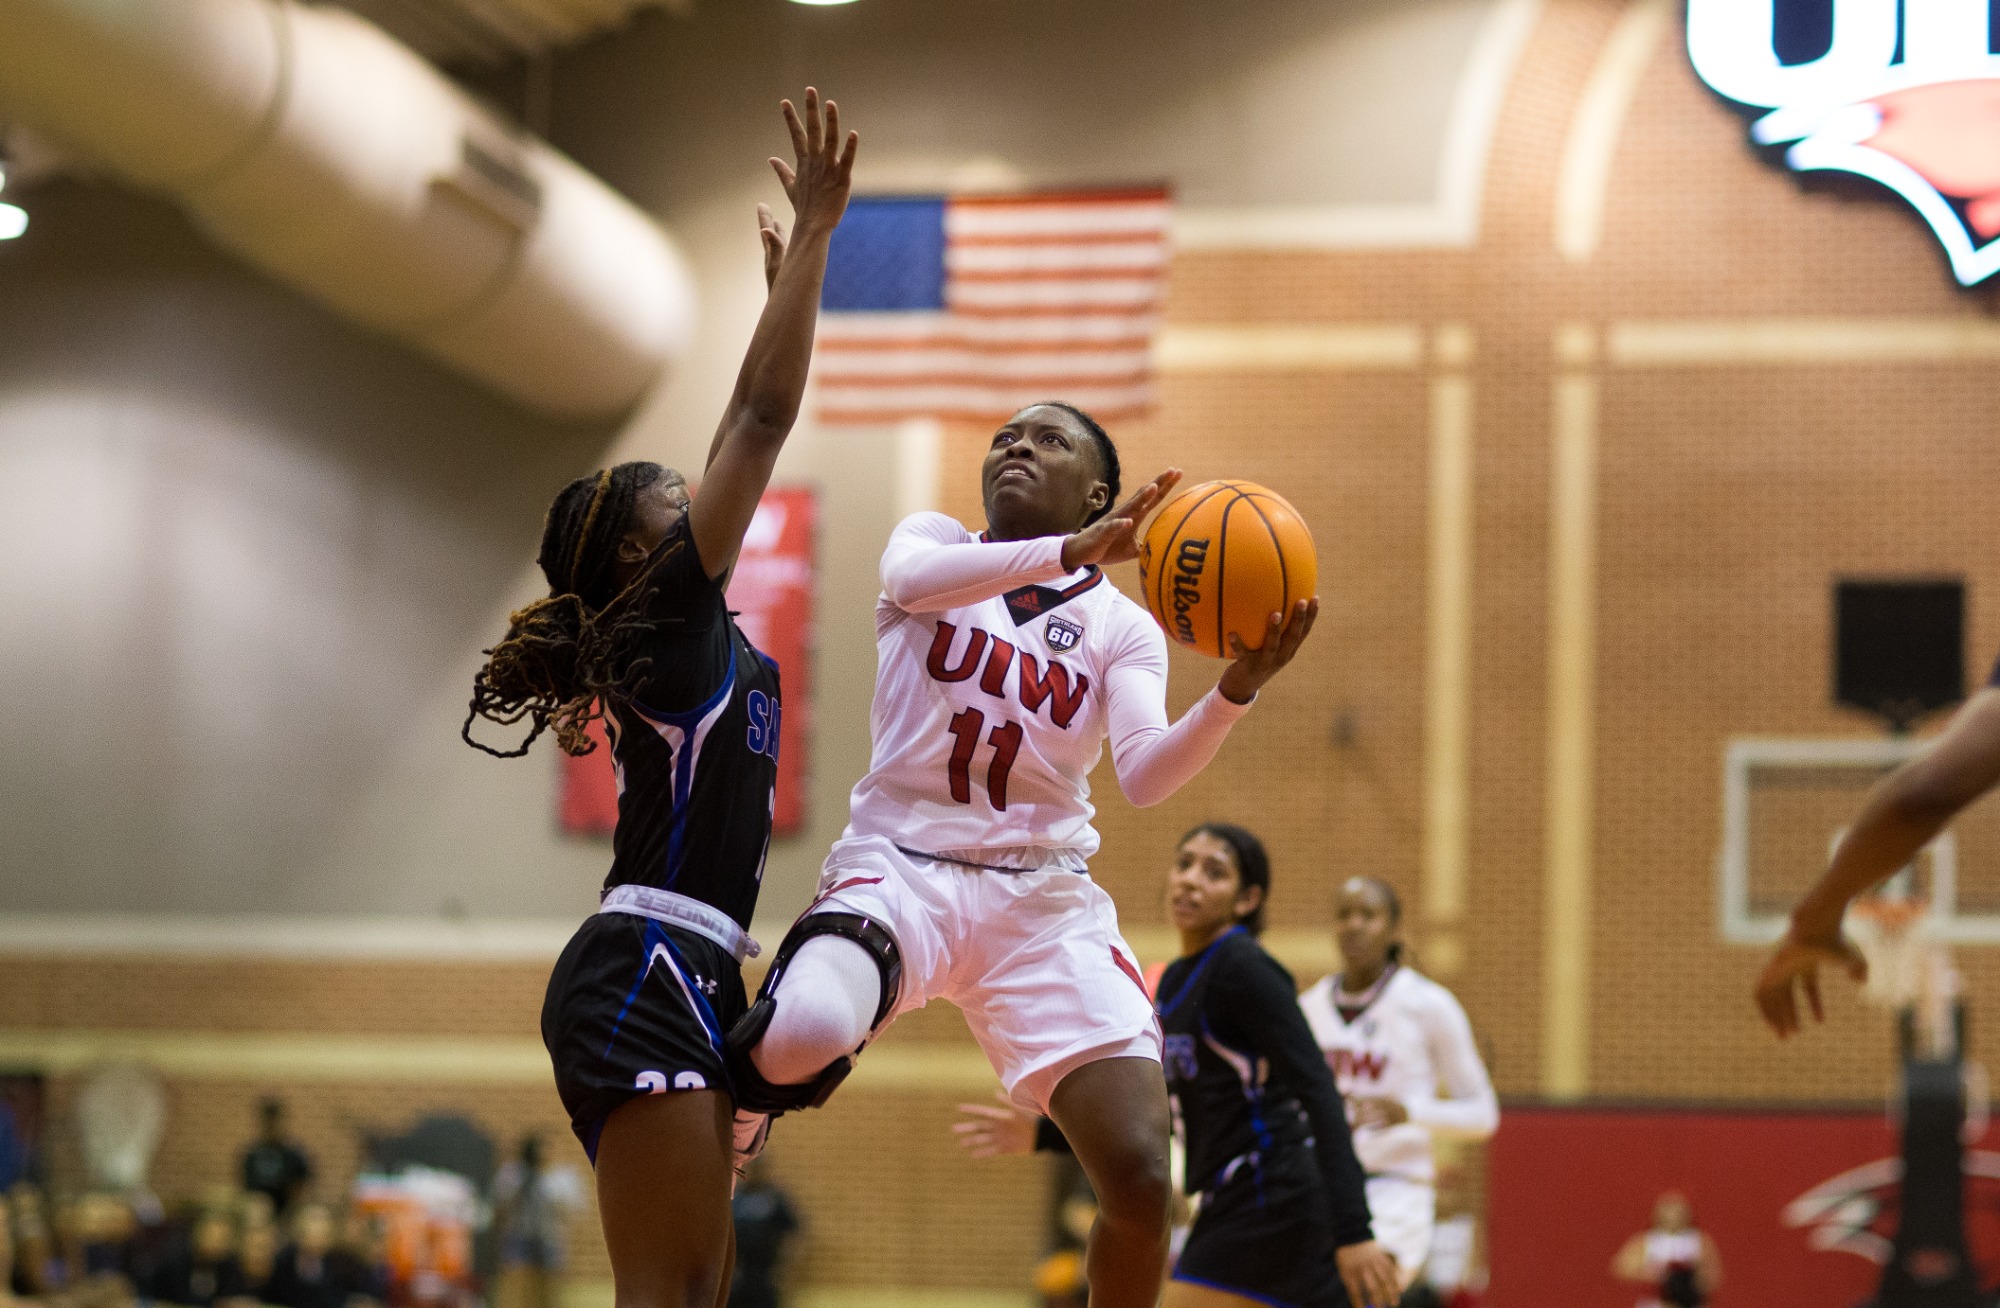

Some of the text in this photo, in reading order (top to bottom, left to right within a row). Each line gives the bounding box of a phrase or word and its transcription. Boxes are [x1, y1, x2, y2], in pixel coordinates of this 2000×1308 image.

[1048, 626, 1075, 648] 60
[1173, 537, 1210, 643] Wilson
[926, 620, 1090, 731] UIW
[948, 706, 1024, 812] 11
